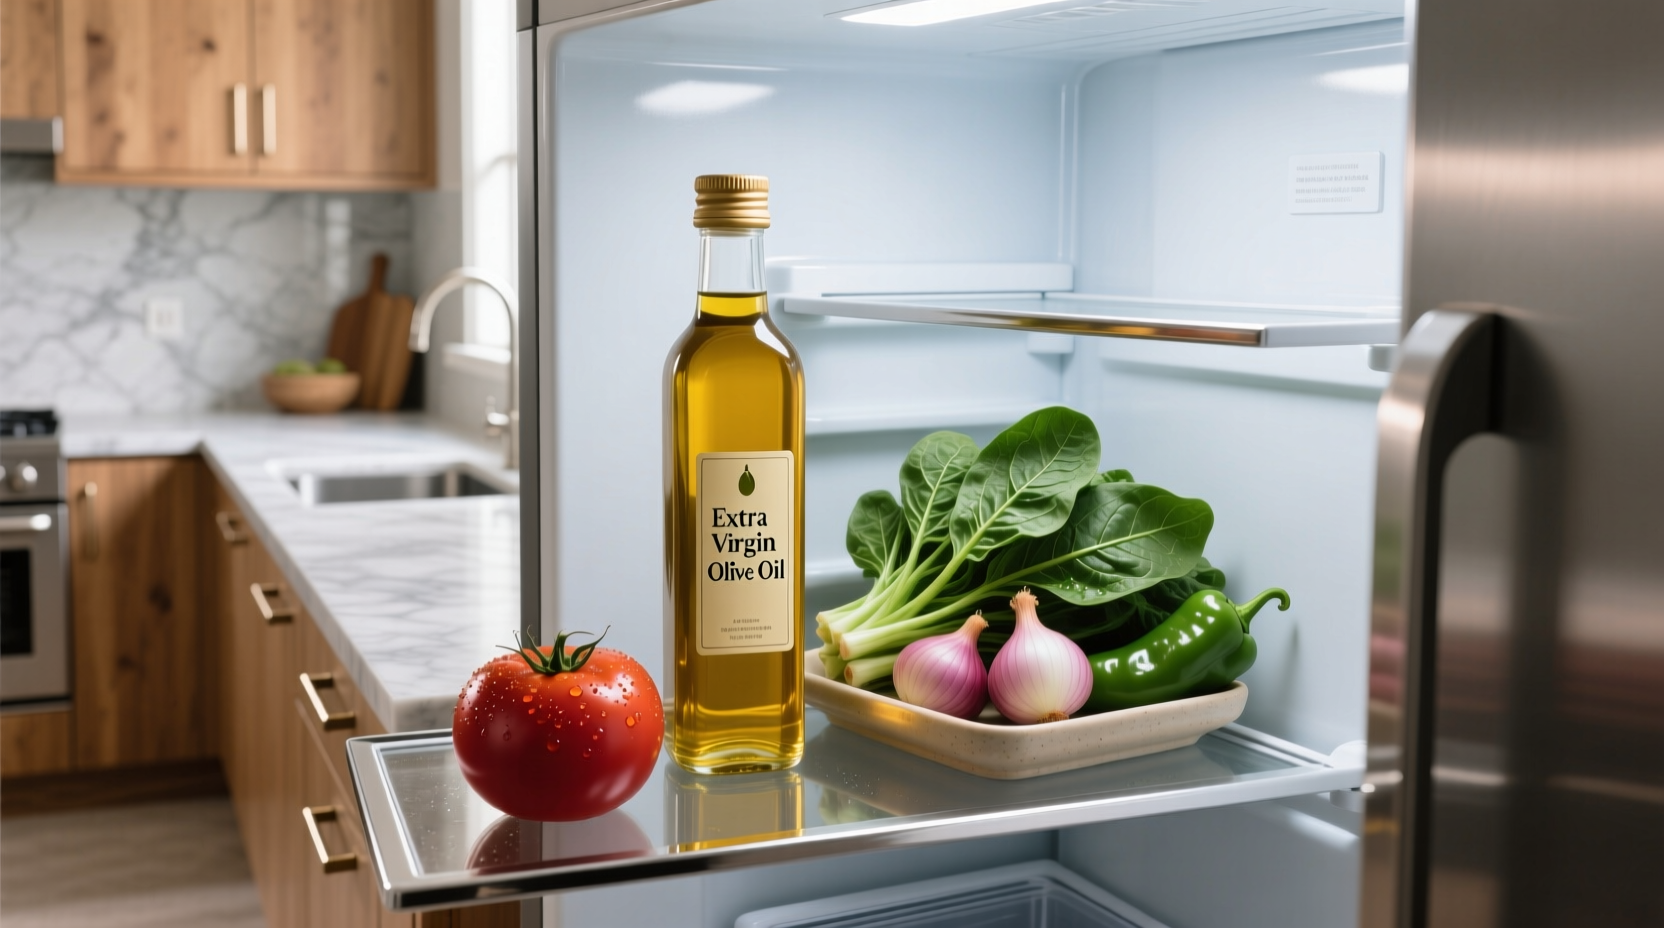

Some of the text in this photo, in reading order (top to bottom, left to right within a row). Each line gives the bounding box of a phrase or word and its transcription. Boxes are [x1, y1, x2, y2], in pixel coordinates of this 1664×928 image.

[712, 507, 768, 528] Extra
[712, 532, 777, 559] Virgin
[708, 559, 785, 582] Olive Oil
